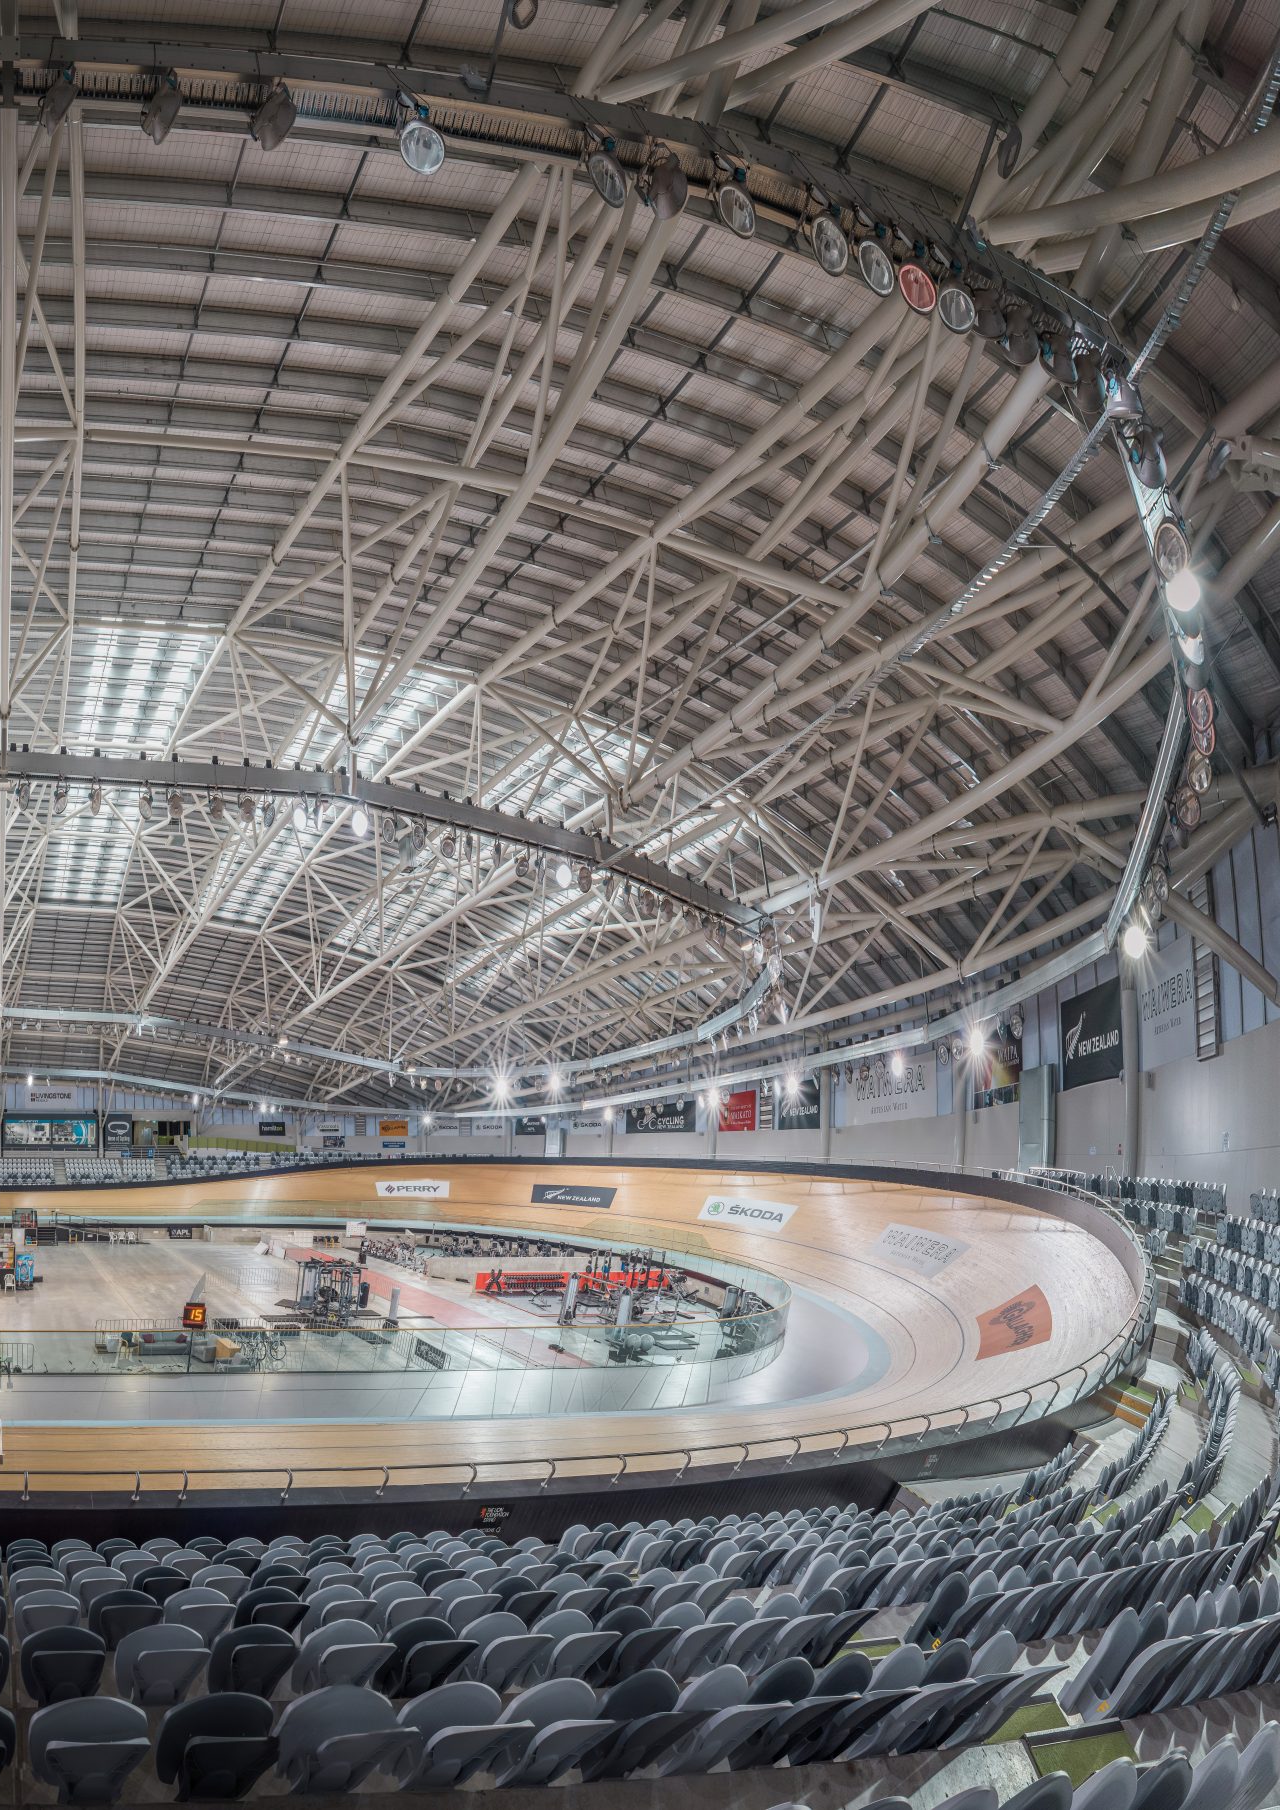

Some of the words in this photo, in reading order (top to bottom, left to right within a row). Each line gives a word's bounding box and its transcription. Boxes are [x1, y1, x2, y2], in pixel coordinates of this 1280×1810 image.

[1078, 1041, 1091, 1057] NEW
[1092, 1029, 1119, 1055] ZEALAND
[789, 1107, 799, 1117] NEW
[799, 1104, 818, 1115] ZEALAND
[657, 1115, 684, 1125] CYCLING
[396, 1185, 441, 1194] PERRY
[572, 1195, 601, 1203] ZEALAND
[728, 1203, 785, 1224] ŠKODA
[882, 1229, 957, 1264] WAIWERA
[191, 1309, 203, 1321] 15
